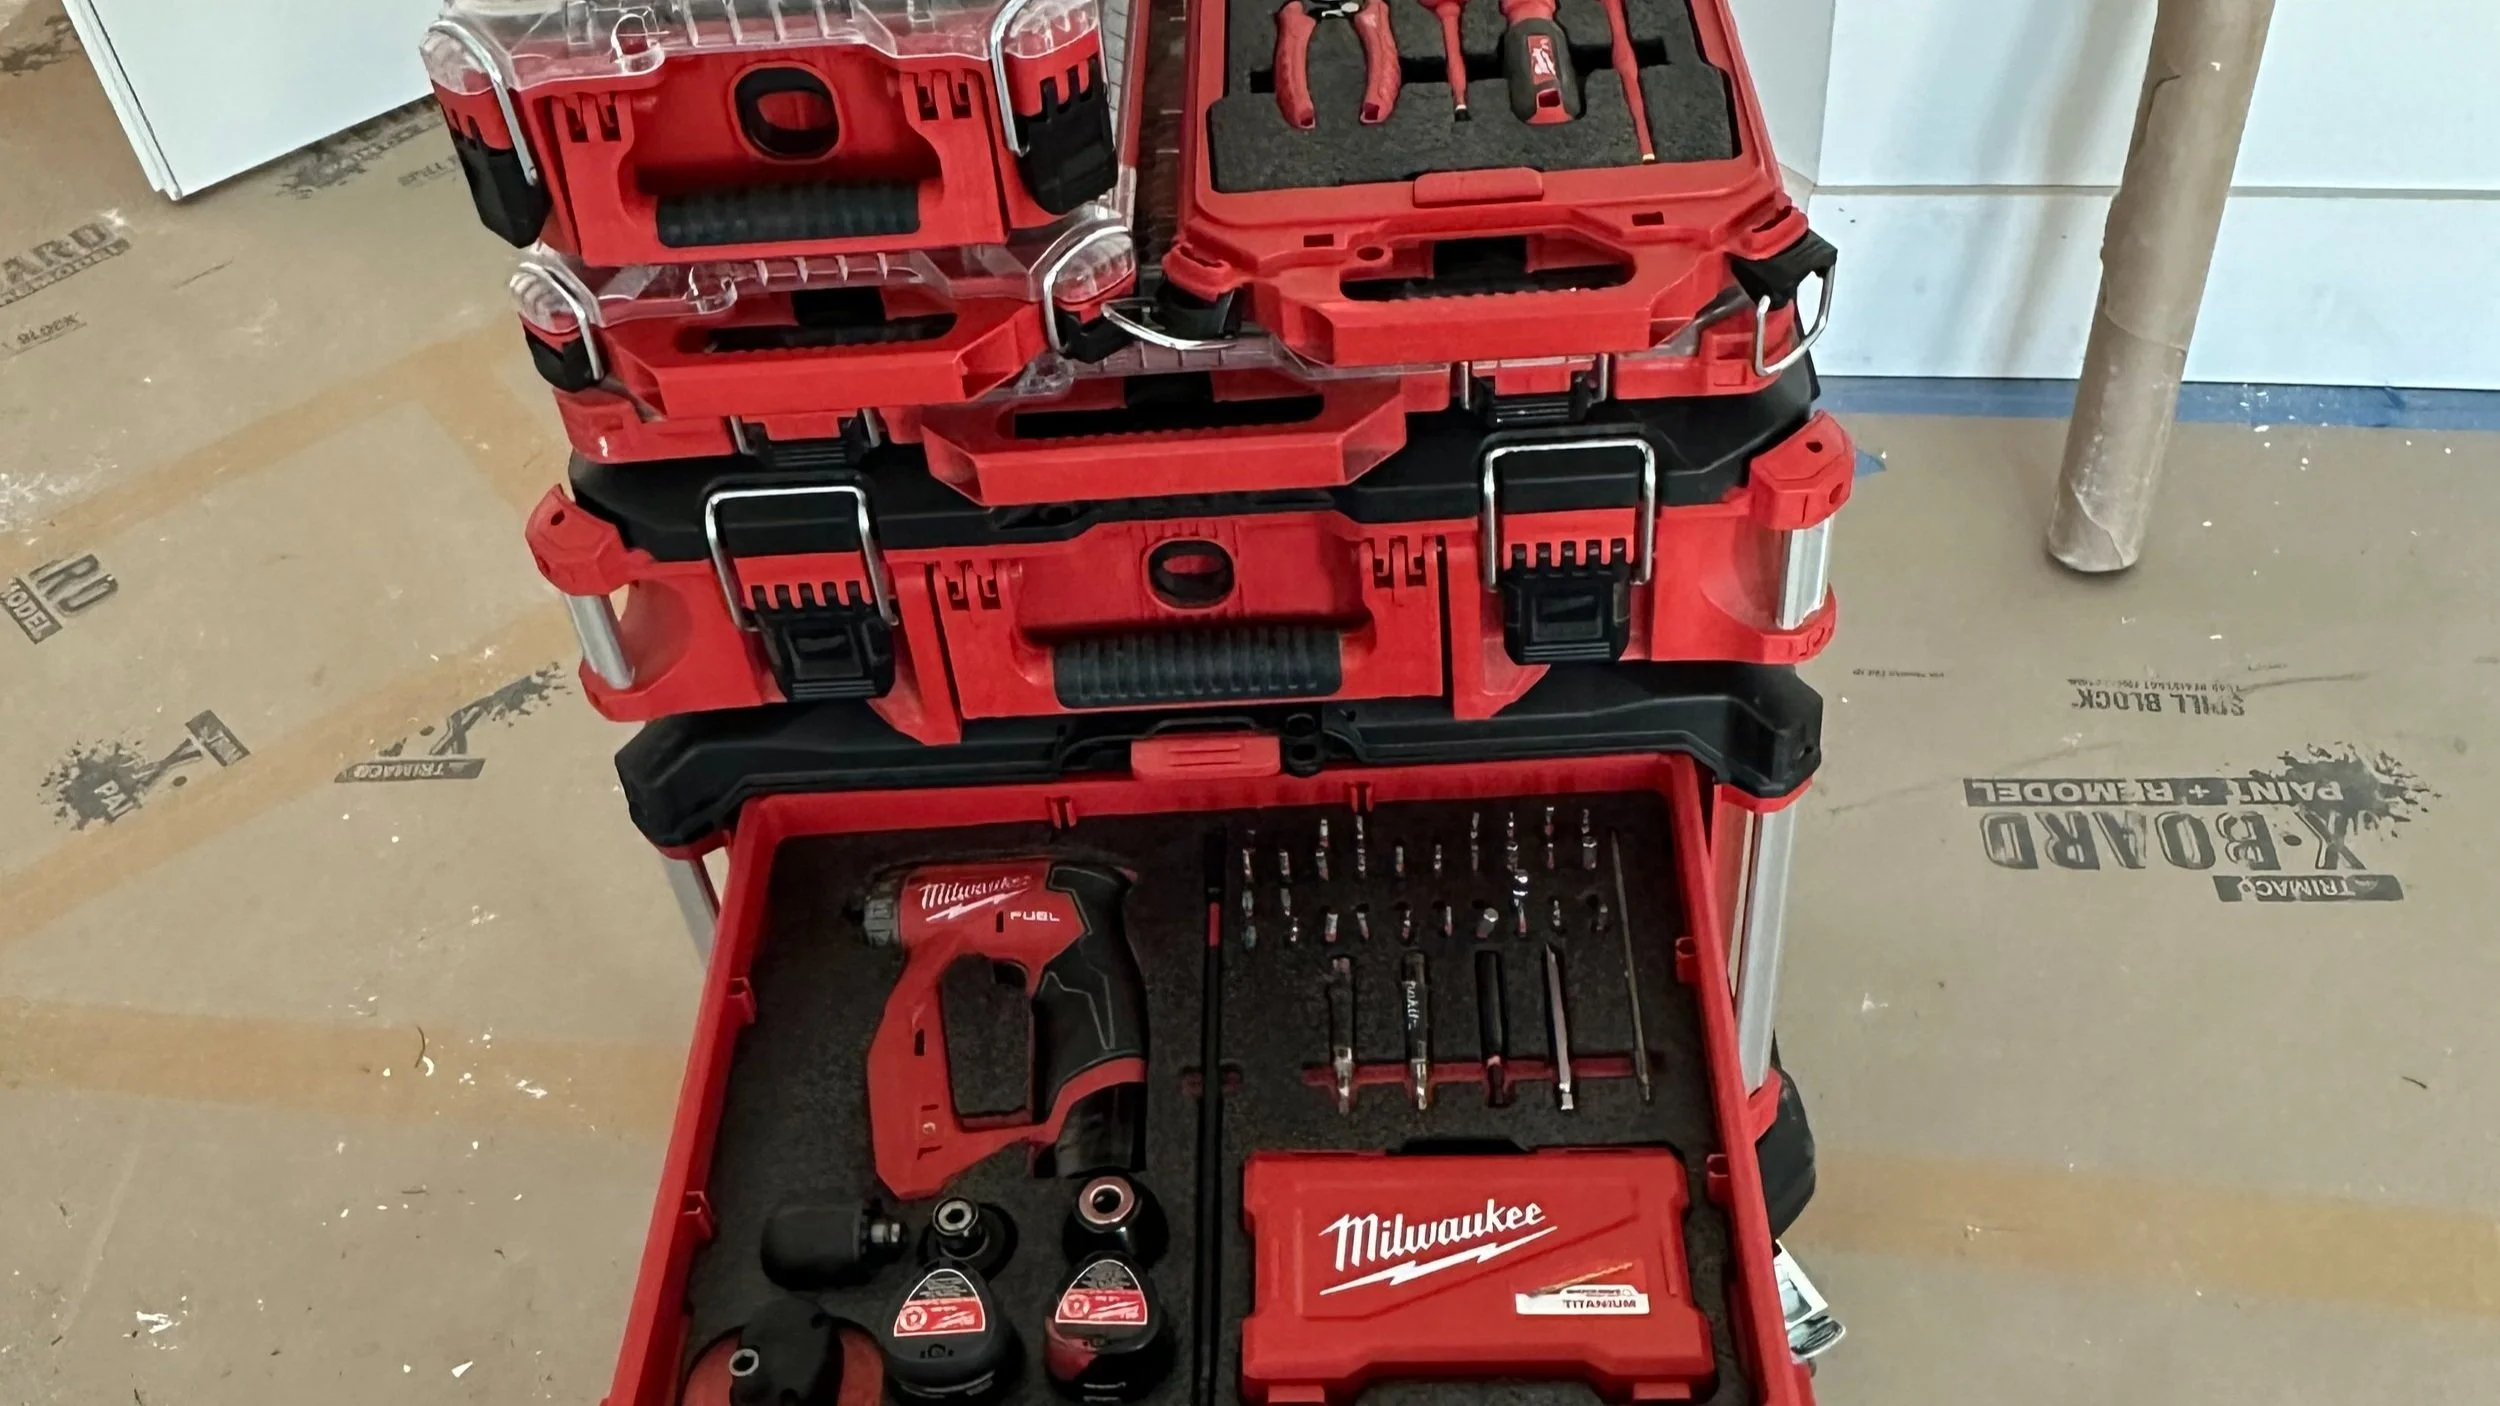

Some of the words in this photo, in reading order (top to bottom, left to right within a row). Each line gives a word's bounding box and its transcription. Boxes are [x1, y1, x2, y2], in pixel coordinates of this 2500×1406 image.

[2075, 689, 2162, 712] BLOCK
[352, 761, 445, 779] TRIMACO
[1972, 781, 2175, 802] REMODEL
[2227, 780, 2345, 801] PAINT
[2236, 878, 2357, 897] TRIMACO
[1009, 911, 1061, 922] FUEL
[1318, 1198, 1547, 1273] Milwaukee
[1562, 1299, 1637, 1309] TITANIUM
